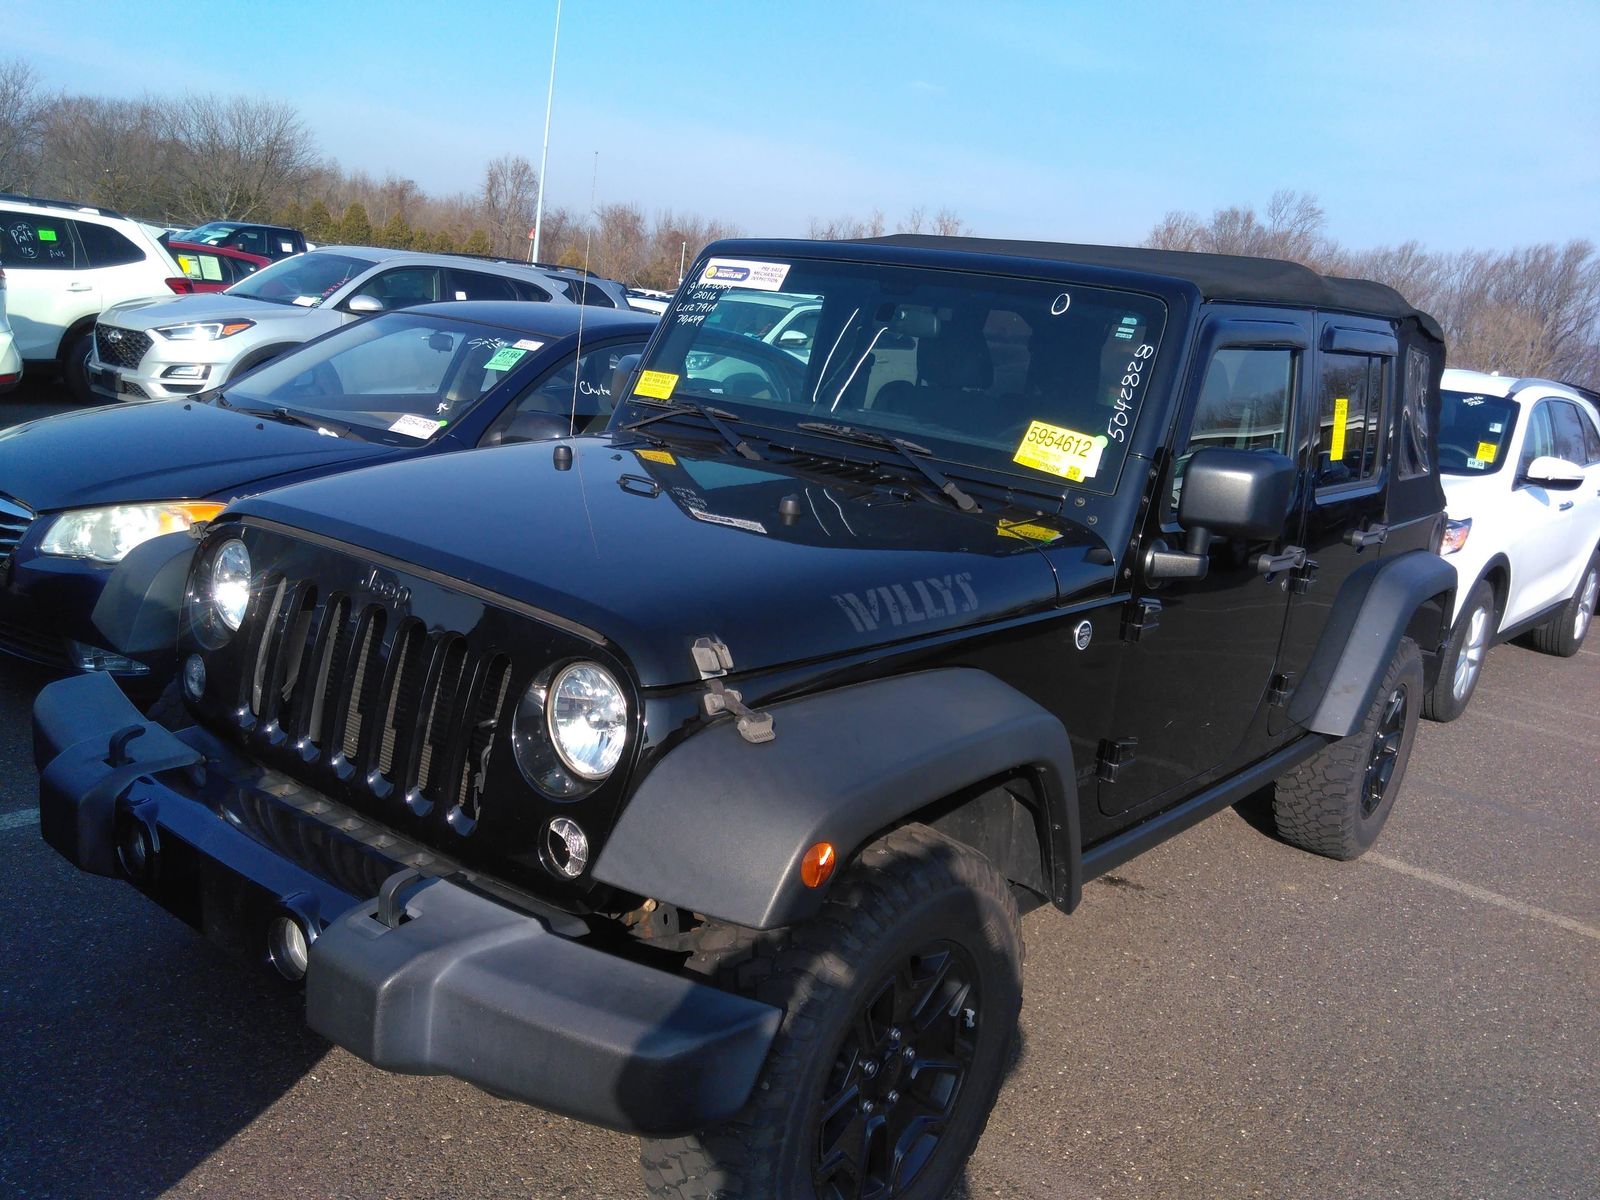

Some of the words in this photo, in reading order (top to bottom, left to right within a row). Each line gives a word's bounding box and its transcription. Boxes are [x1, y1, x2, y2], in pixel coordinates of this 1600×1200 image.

[692, 290, 717, 301] 2016
[579, 380, 611, 396] Chute
[1107, 344, 1154, 442] 5042828
[1027, 426, 1093, 457] 5954612
[360, 569, 412, 609] Jeep
[831, 571, 979, 633] WILLYS
